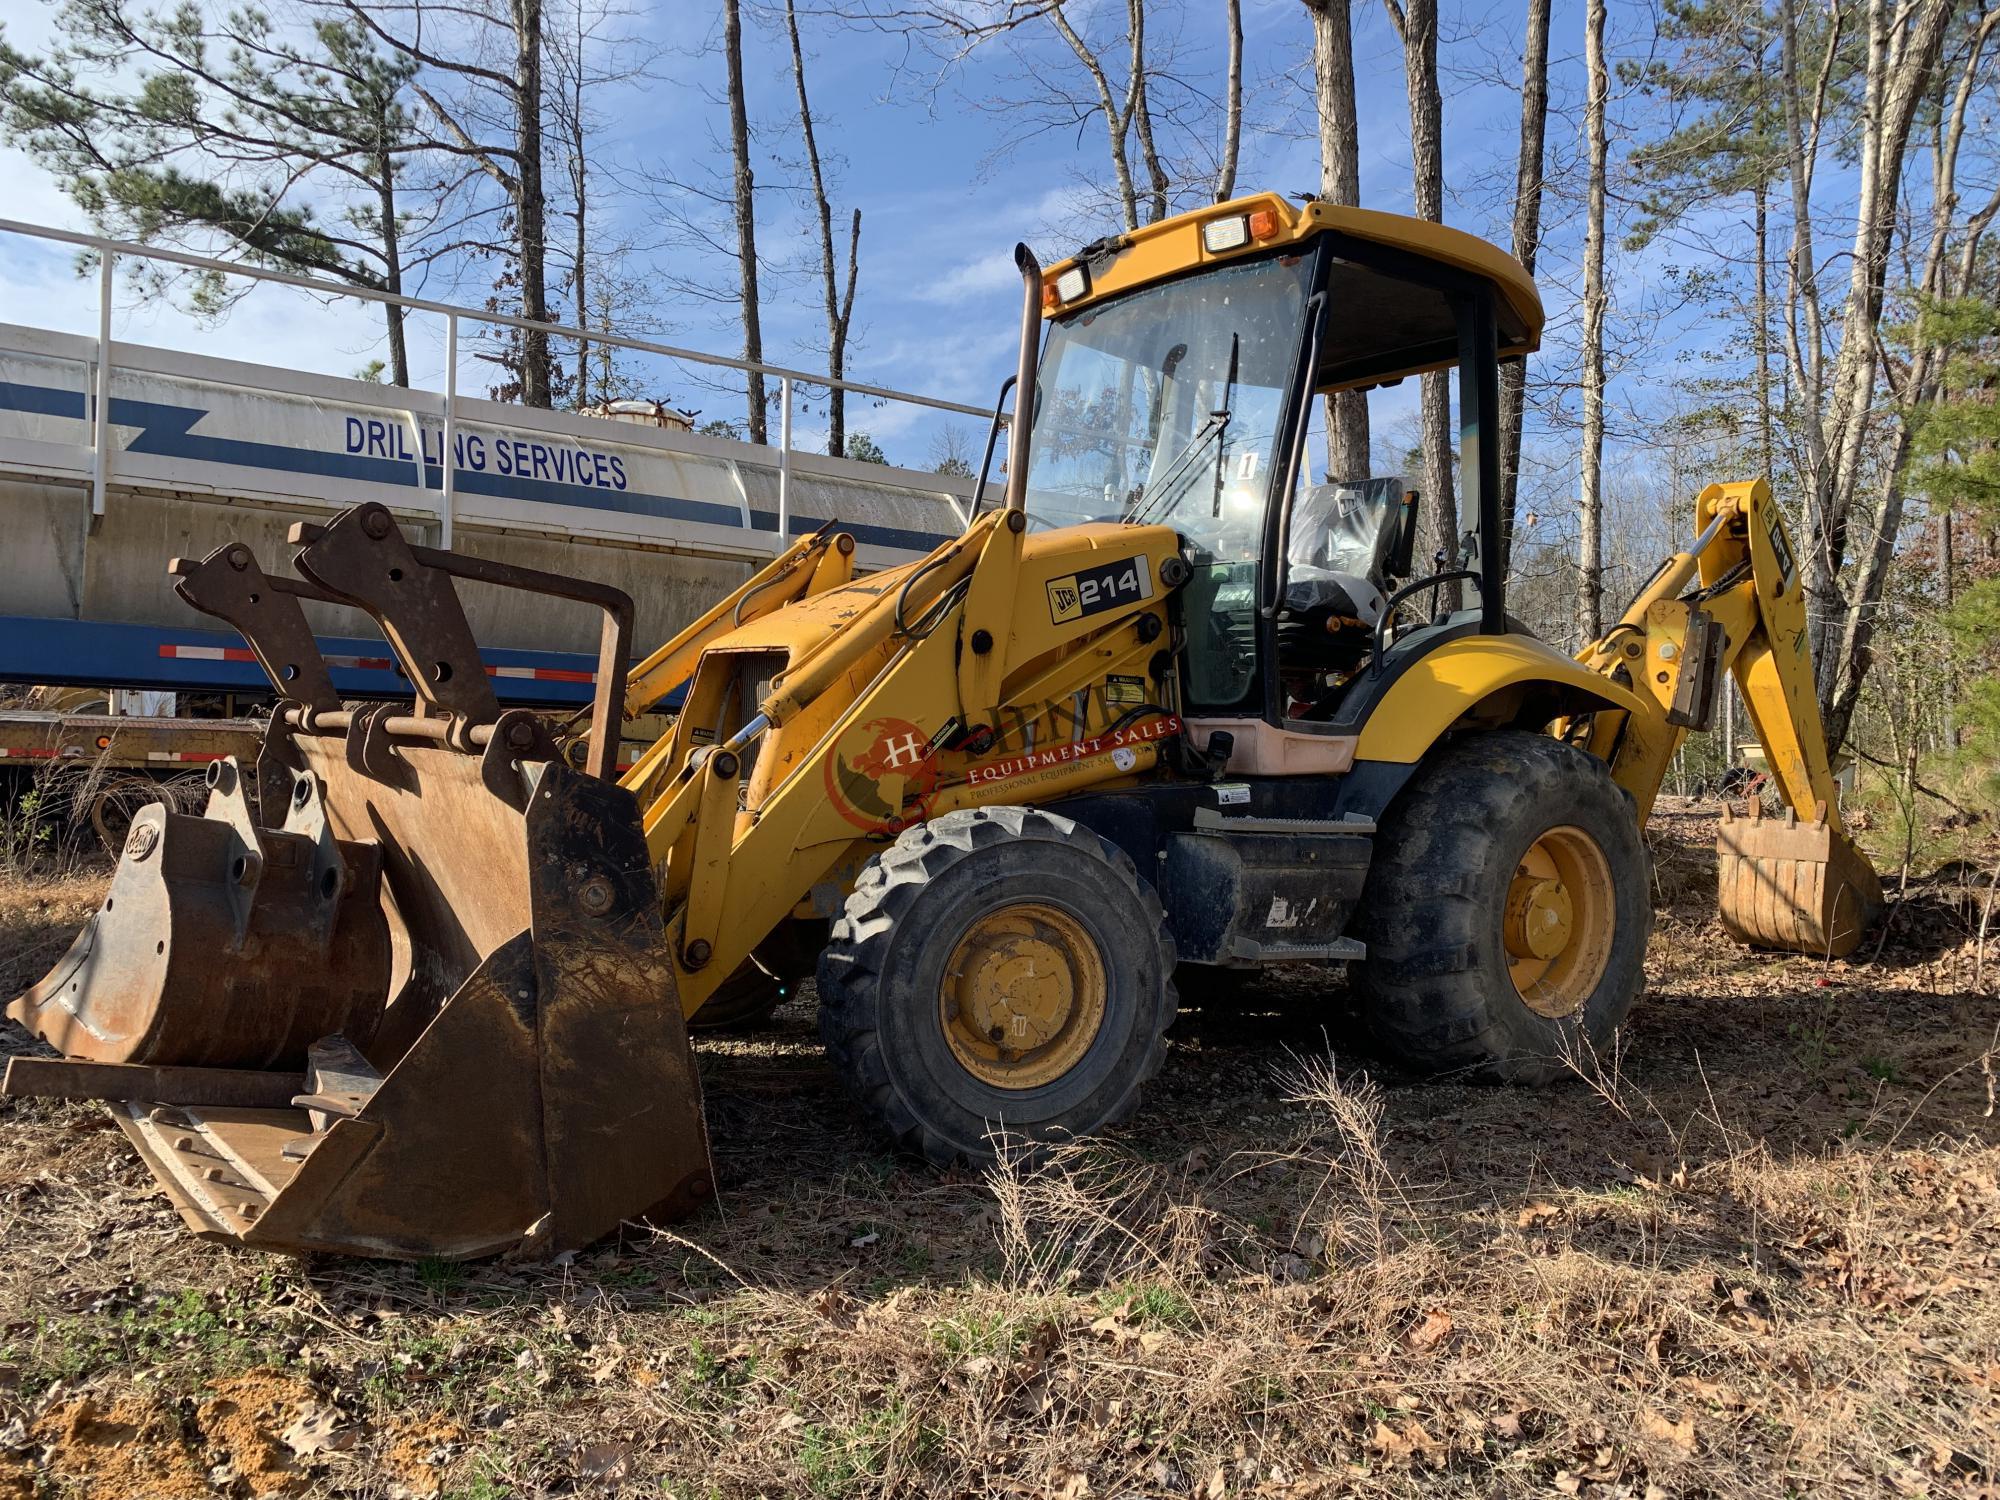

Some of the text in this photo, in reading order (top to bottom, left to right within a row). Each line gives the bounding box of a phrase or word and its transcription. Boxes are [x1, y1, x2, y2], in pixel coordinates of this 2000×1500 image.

[346, 417, 627, 490] DRILLING SERVICES
[1773, 526, 1791, 573] 214
[1055, 589, 1077, 611] JCB
[1080, 569, 1138, 605] 214
